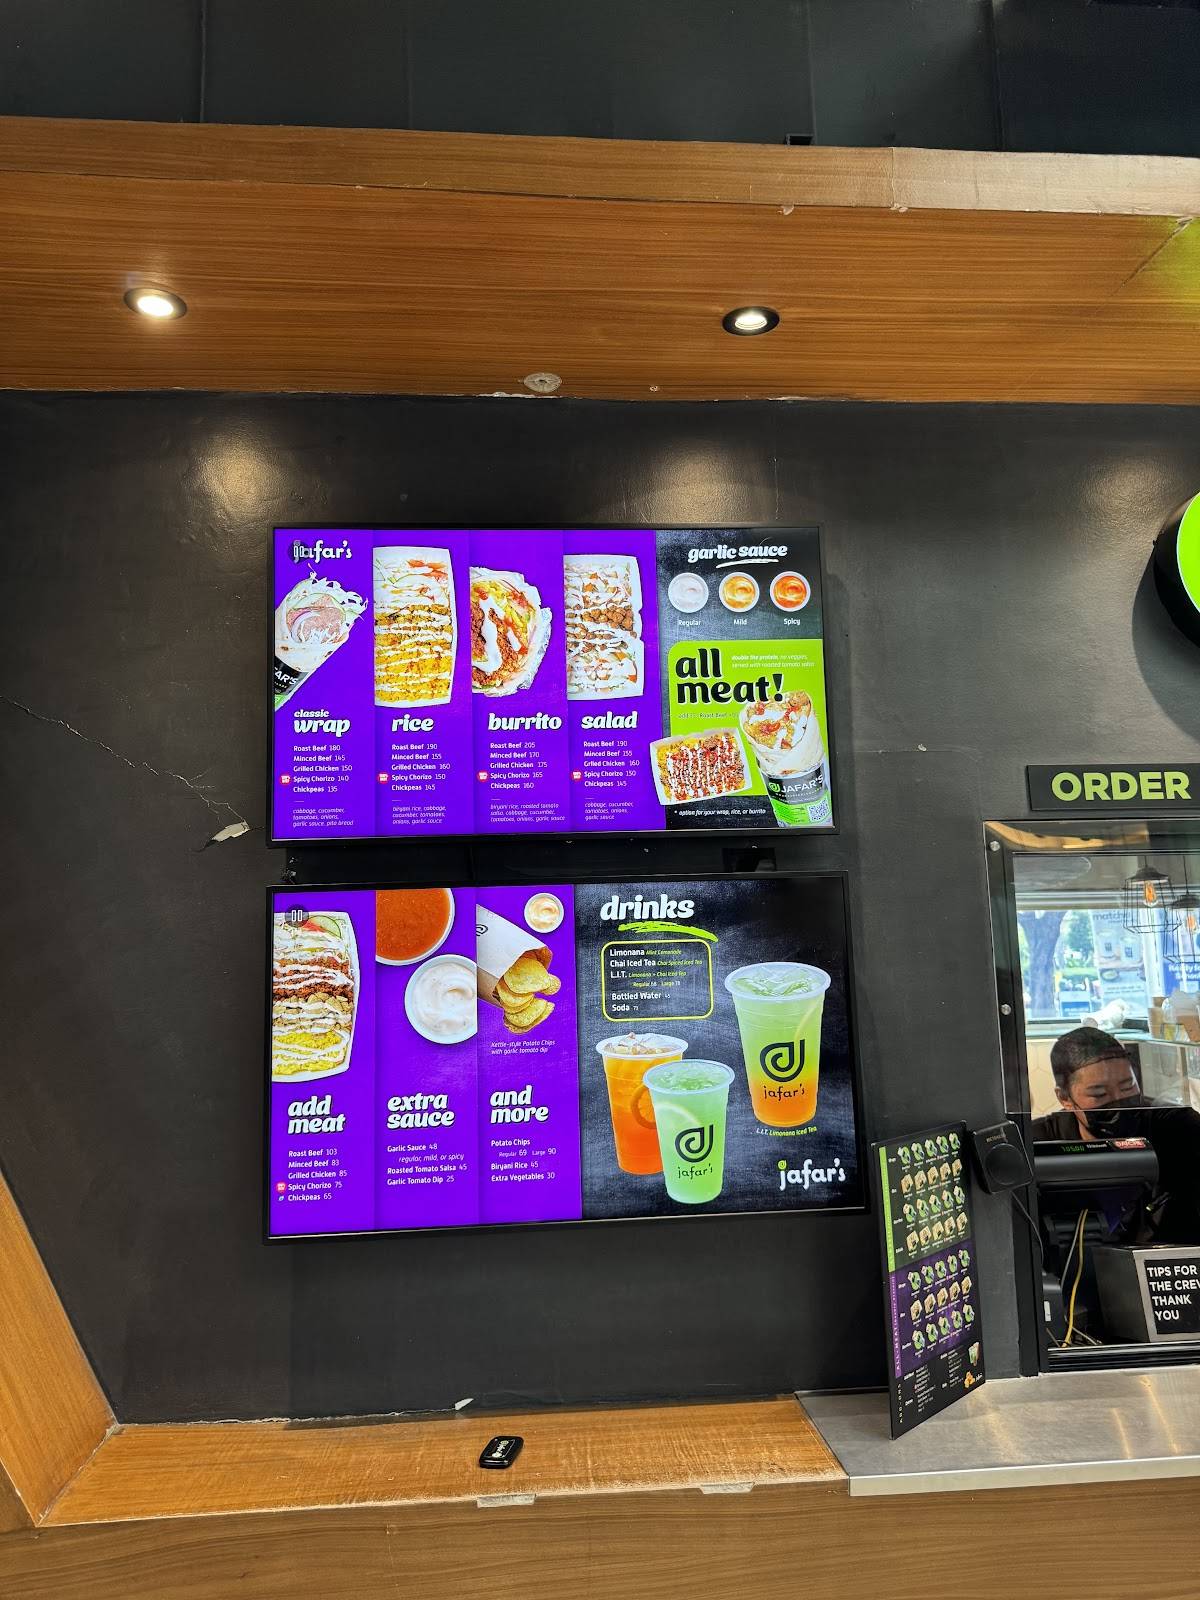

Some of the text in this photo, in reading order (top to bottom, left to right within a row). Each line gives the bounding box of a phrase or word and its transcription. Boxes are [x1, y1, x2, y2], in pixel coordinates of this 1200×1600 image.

[294, 540, 352, 563] jafar's
[688, 545, 788, 563] garlic sauce
[784, 618, 800, 626] Spicy
[676, 648, 722, 678] all
[677, 673, 783, 703] meat!
[294, 709, 329, 717] classic
[488, 712, 562, 730] burrito
[581, 711, 638, 729] salad
[293, 719, 351, 737] wrap
[391, 714, 434, 732] rice
[392, 784, 422, 792] Chickpeas
[781, 774, 823, 792] JAFAR'S
[1051, 771, 1192, 801] ORDER
[600, 894, 695, 920] drinks
[610, 971, 627, 979] L.I.T.
[612, 1004, 630, 1012] Soda
[541, 1039, 556, 1047] Chips
[490, 1084, 532, 1106] and
[763, 1083, 805, 1101] jafar's
[287, 1094, 332, 1116] add
[387, 1093, 448, 1111] extra
[387, 1111, 455, 1129] sauce
[490, 1106, 549, 1123] more
[287, 1113, 346, 1134] meat
[513, 1138, 531, 1146] Chips
[399, 1155, 421, 1163] regular,
[448, 1153, 464, 1161] spicy
[387, 1166, 413, 1174] Roasted
[440, 1164, 456, 1172] Salsa
[491, 1163, 513, 1171] Biryani
[677, 1163, 713, 1180] jafar's
[778, 1158, 846, 1191] jafar's
[432, 1176, 443, 1184] Dip
[509, 1172, 544, 1181] Vegetables
[288, 1183, 305, 1191] Spicy
[288, 1194, 320, 1202] Chickpeas
[1147, 1264, 1197, 1277] TIPS FOR
[1149, 1281, 1172, 1292] THE
[1152, 1294, 1192, 1306] THANK
[1155, 1309, 1179, 1320] YOU
